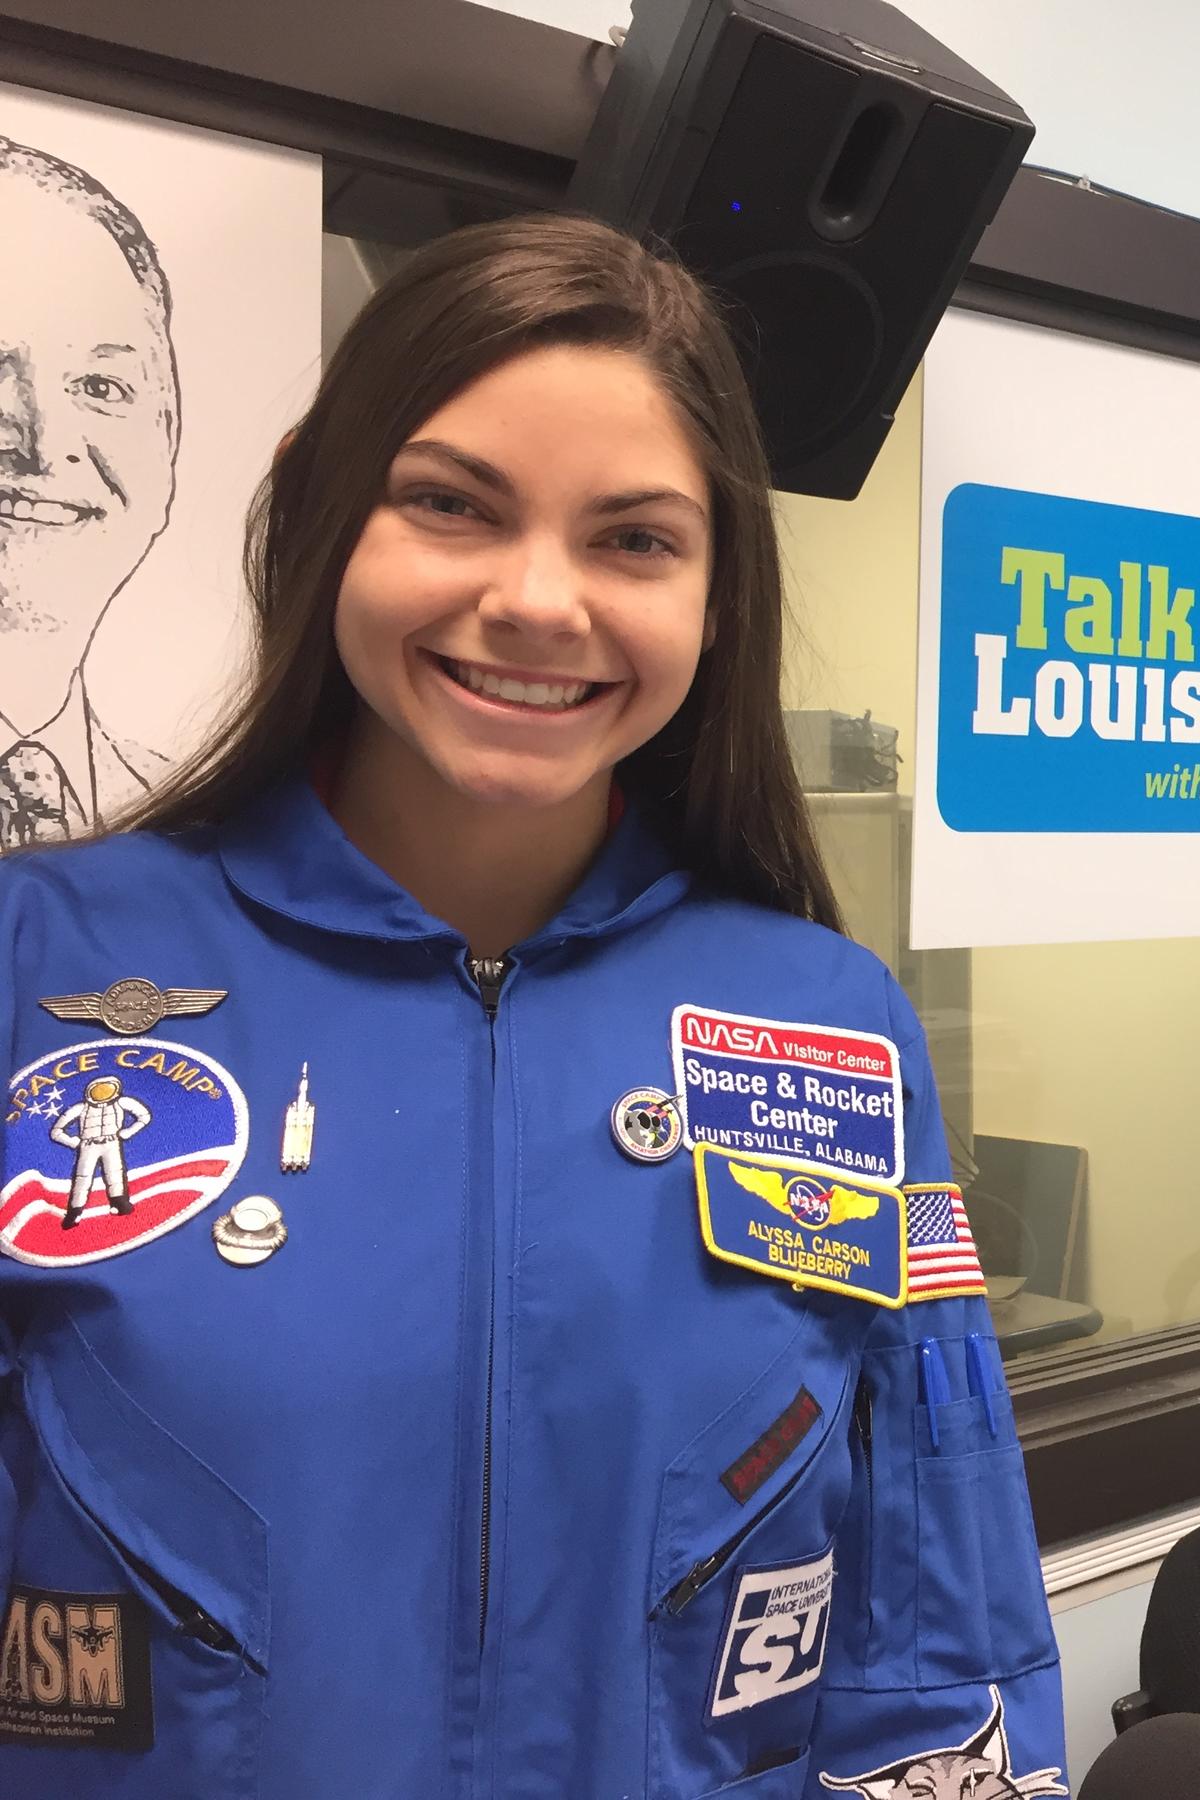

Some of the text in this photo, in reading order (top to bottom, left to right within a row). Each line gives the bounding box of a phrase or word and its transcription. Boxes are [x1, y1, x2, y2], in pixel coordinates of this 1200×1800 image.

[1001, 546, 1195, 662] Talk
[687, 1017, 886, 1071] NASA Visitor Center
[685, 1058, 893, 1117] Space & Rocket
[750, 1100, 838, 1138] Center
[694, 1125, 888, 1172] HUNTSVILLE, ALABAMA
[748, 1220, 870, 1267] ALYSSA CARSON
[768, 1243, 851, 1280] BLUEBERRY
[766, 1599, 799, 1618] SPACE
[39, 1710, 70, 1723] Space
[72, 1712, 115, 1725] Museum
[44, 1725, 95, 1737] Institution
